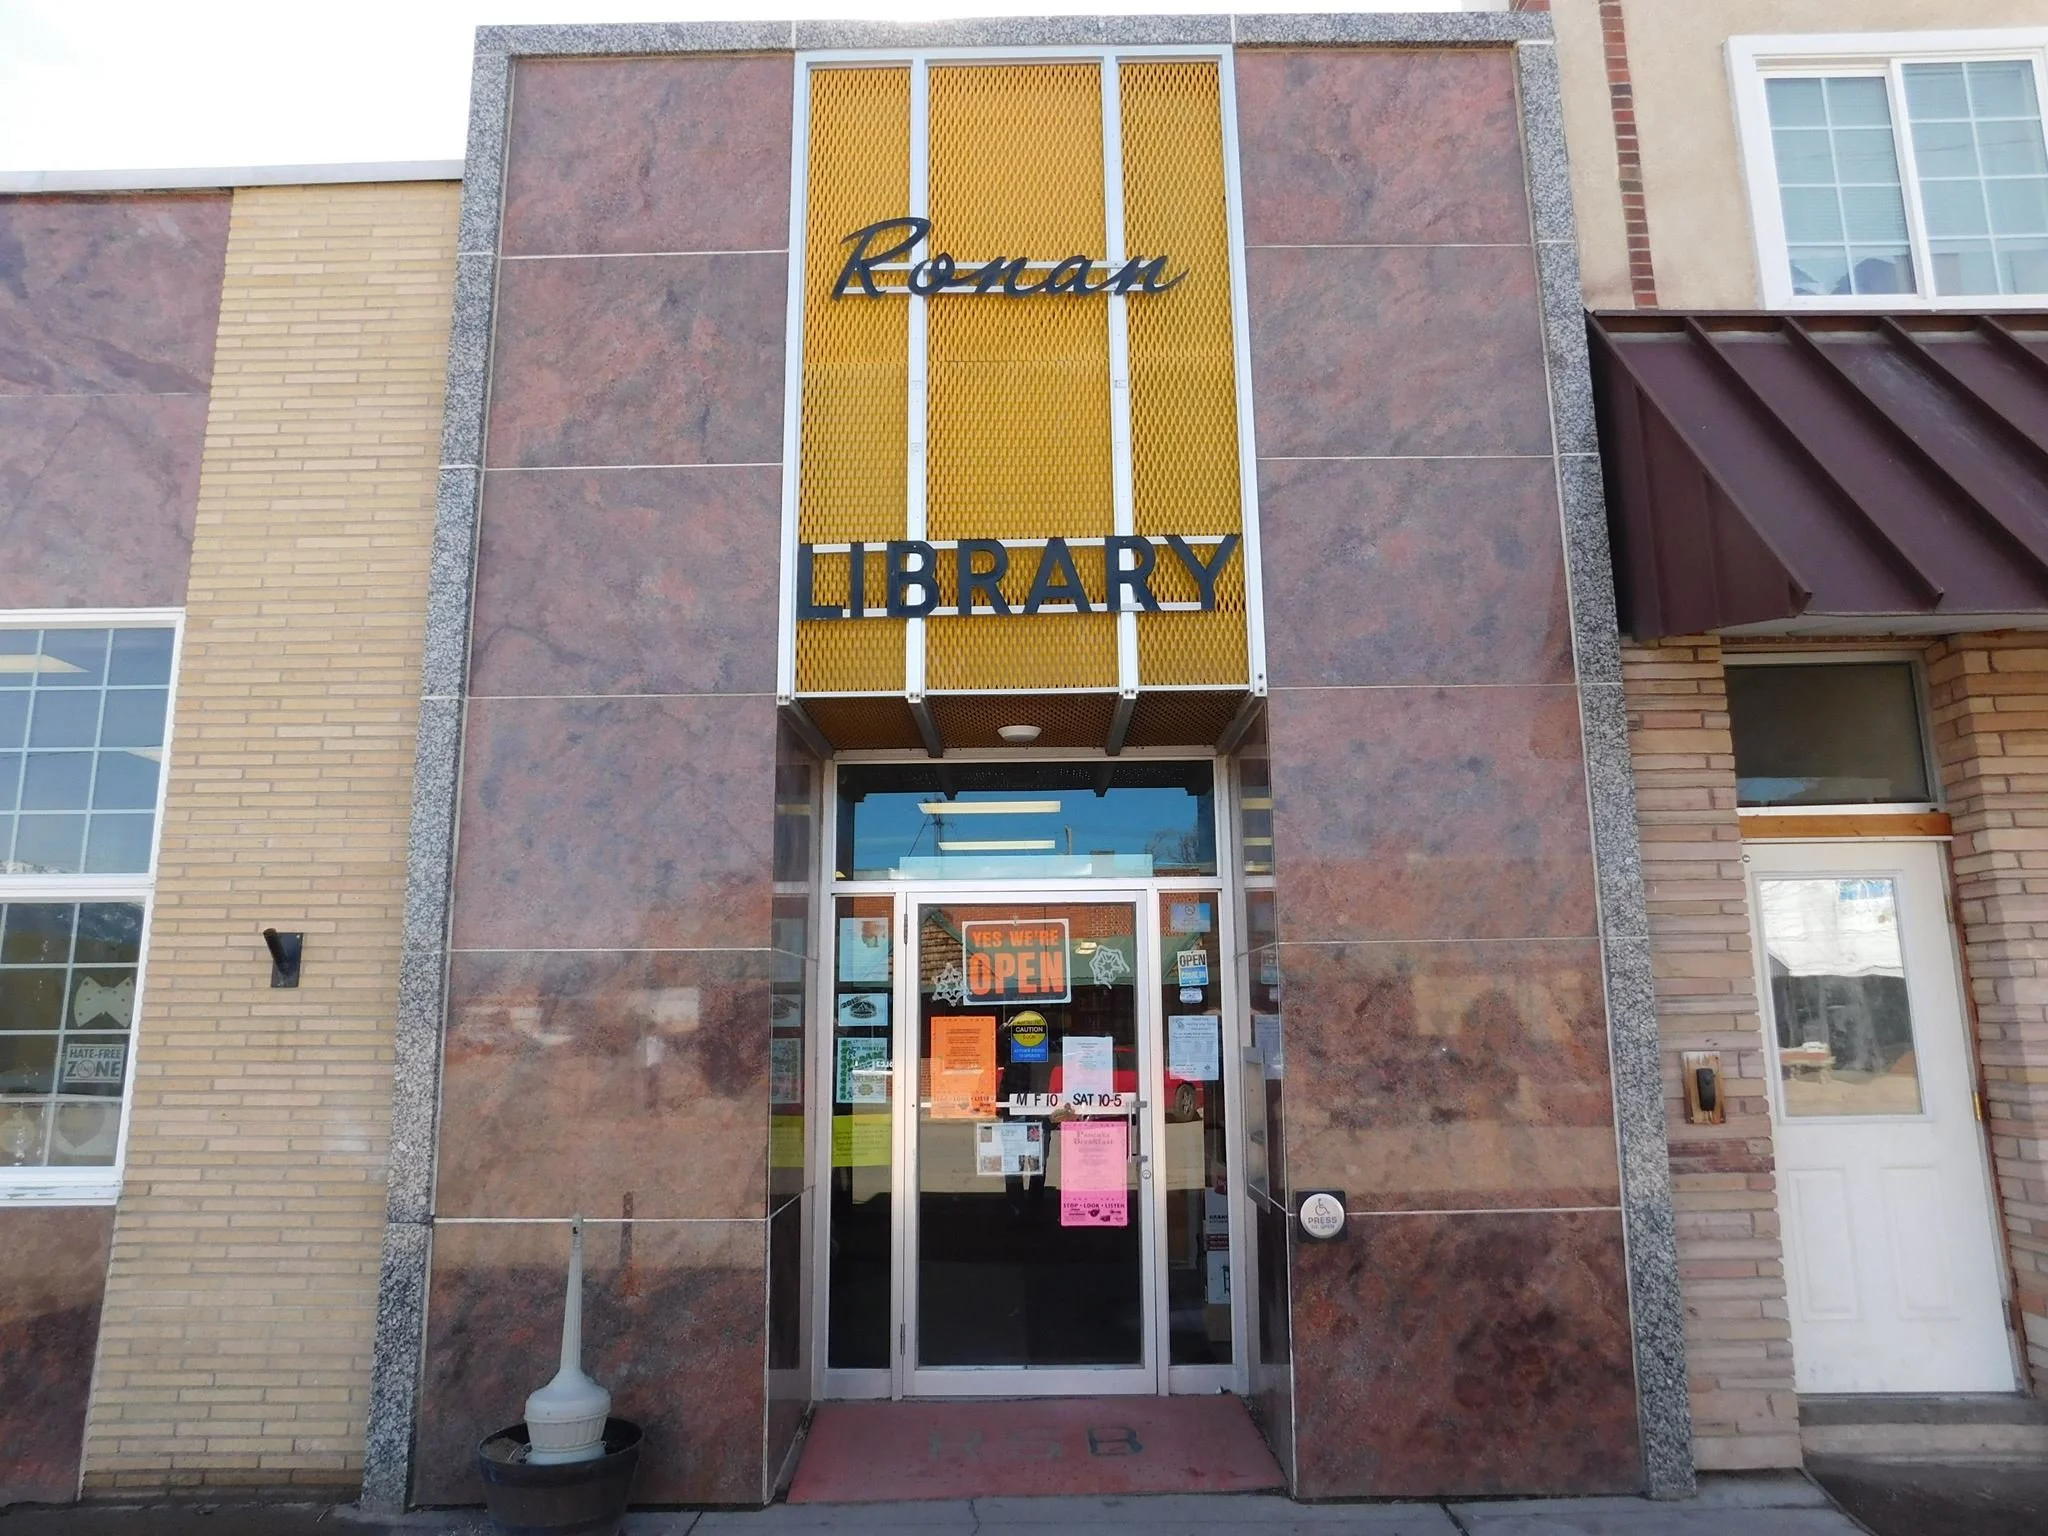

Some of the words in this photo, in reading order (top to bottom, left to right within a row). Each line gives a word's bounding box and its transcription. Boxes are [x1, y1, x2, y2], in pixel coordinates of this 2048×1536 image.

[832, 216, 1190, 301] Ronan
[798, 533, 1241, 619] LIBRARY
[971, 930, 1003, 948] YES
[1009, 928, 1059, 947] WE'RE
[1180, 953, 1206, 967] OPEN
[969, 951, 1064, 996] OPEN
[69, 1048, 121, 1059] HATE-FREE
[66, 1060, 121, 1078] ZONE
[1016, 1093, 1028, 1106] M
[1034, 1093, 1042, 1106] F
[1046, 1094, 1059, 1107] 10
[1073, 1093, 1095, 1106] SAT
[1098, 1094, 1122, 1107] 10-5
[1307, 1216, 1338, 1224] PRESS
